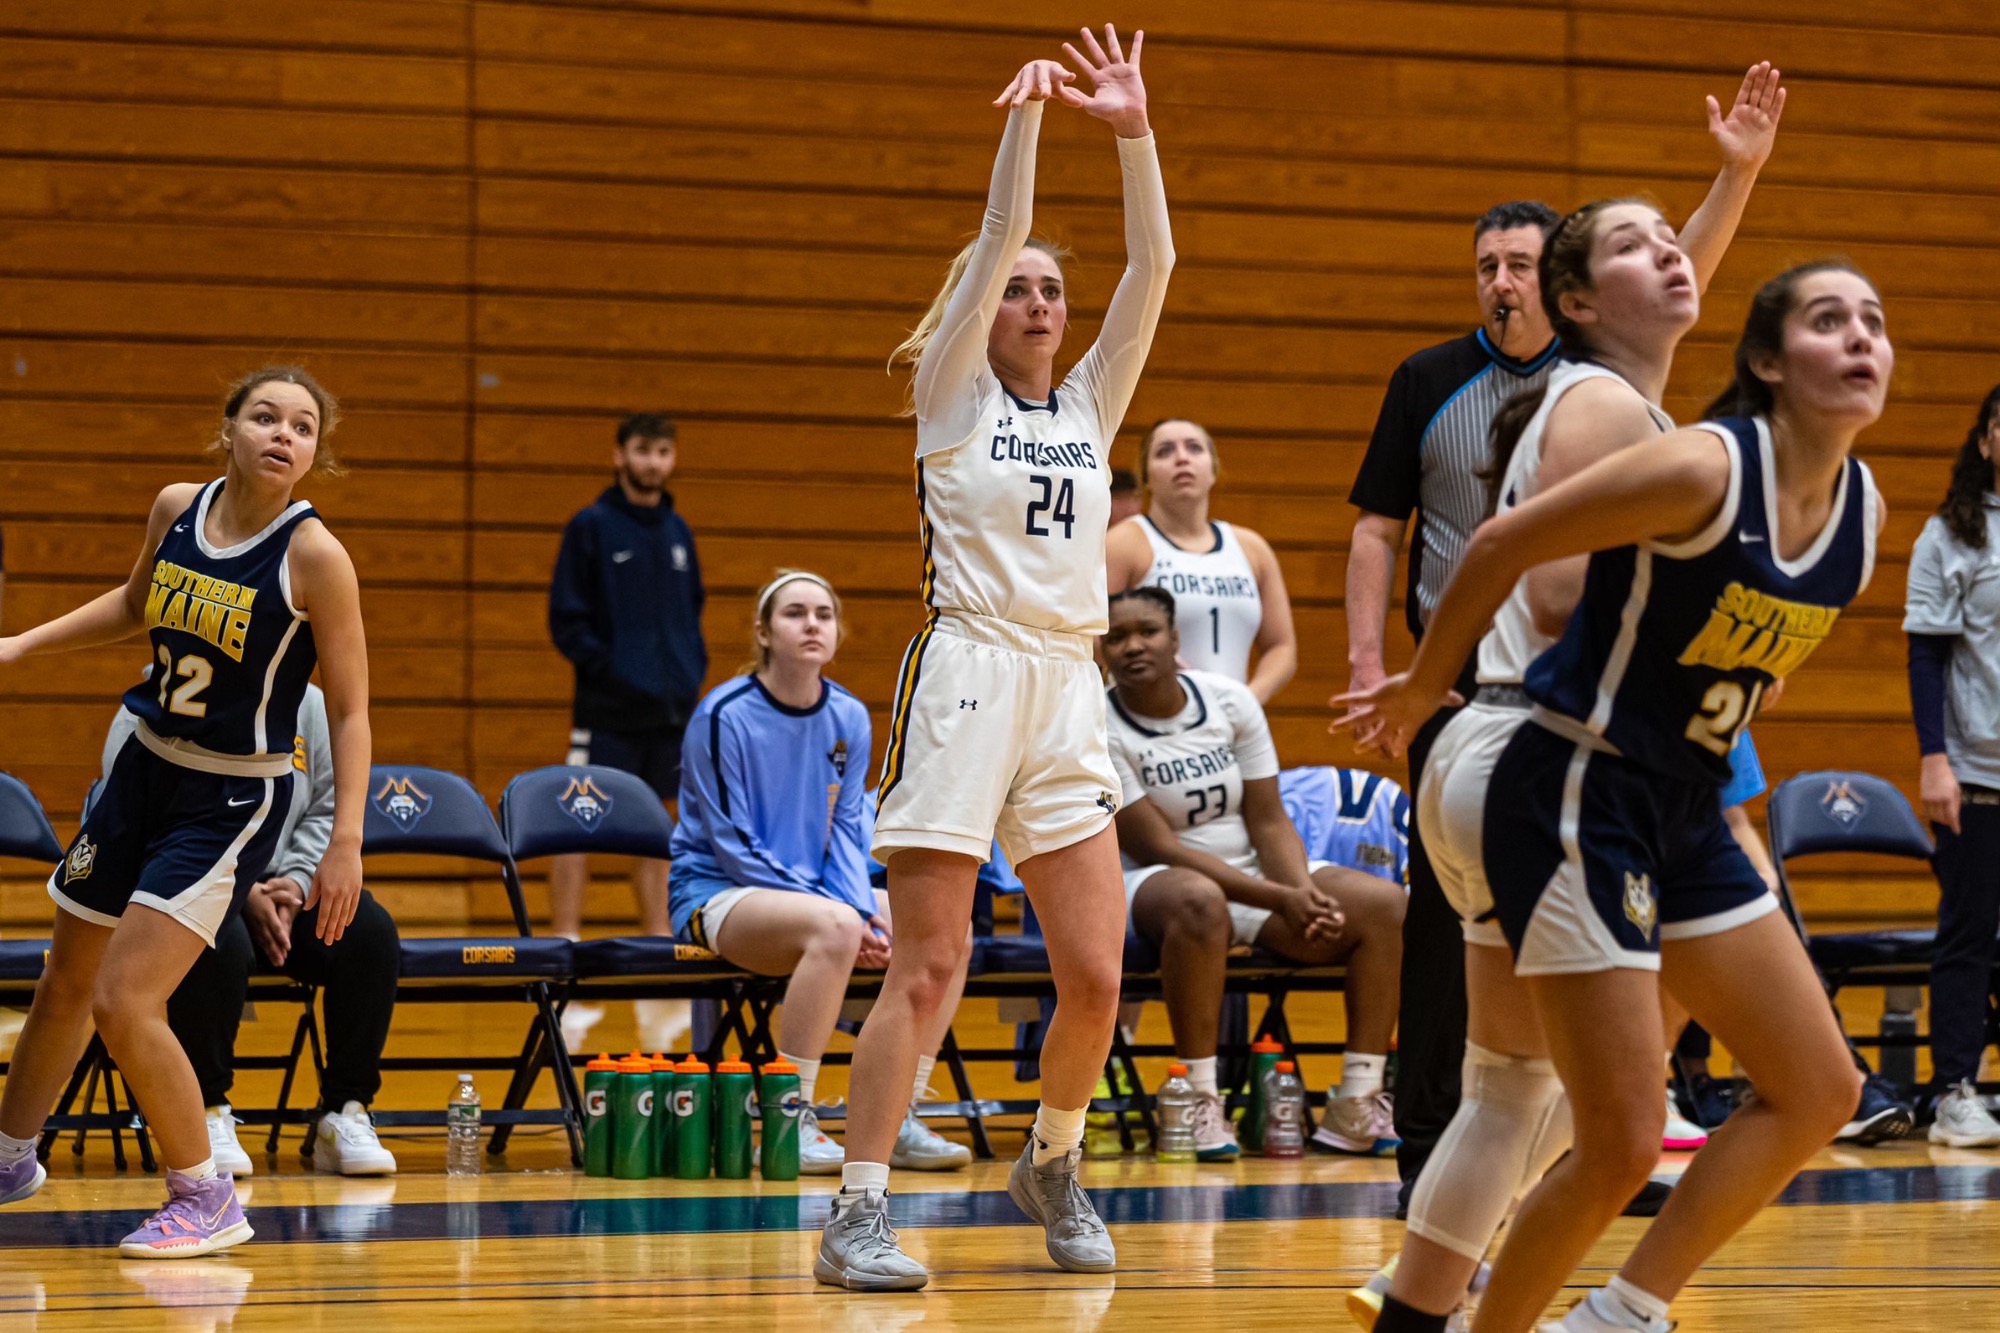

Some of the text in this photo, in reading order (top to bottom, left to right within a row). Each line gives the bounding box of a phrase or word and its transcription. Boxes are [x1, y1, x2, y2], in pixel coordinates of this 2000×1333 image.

[991, 434, 1097, 469] CORSAIRS
[1026, 474, 1075, 539] 24
[153, 560, 259, 609] SOUTHERN
[145, 582, 252, 663] MAINE
[1209, 607, 1220, 654] 1
[1185, 783, 1227, 827] 23
[463, 946, 516, 964] CORSAIRS
[586, 1090, 607, 1117] G
[673, 1090, 694, 1117] G
